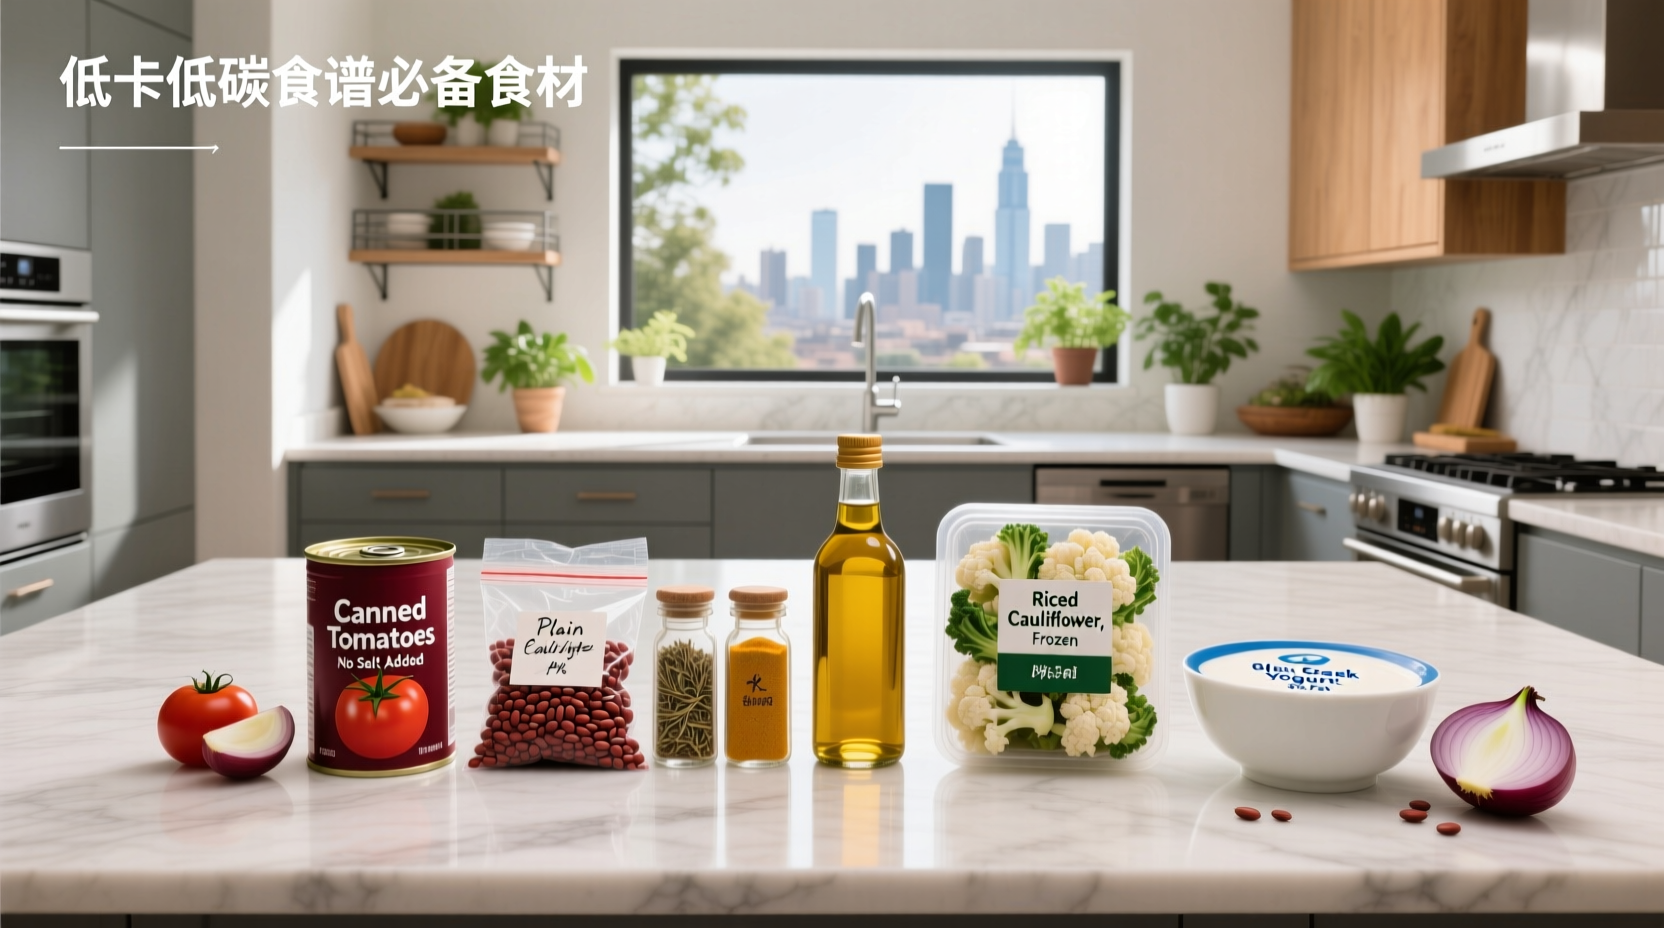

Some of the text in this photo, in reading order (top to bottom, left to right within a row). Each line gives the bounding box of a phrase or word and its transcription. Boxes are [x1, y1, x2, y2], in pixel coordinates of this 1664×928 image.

[1032, 590, 1078, 607] Riced
[334, 595, 426, 624] Canned
[537, 617, 583, 636] Plain
[327, 625, 435, 650] Tomatoes
[1032, 632, 1078, 647] Frozen
